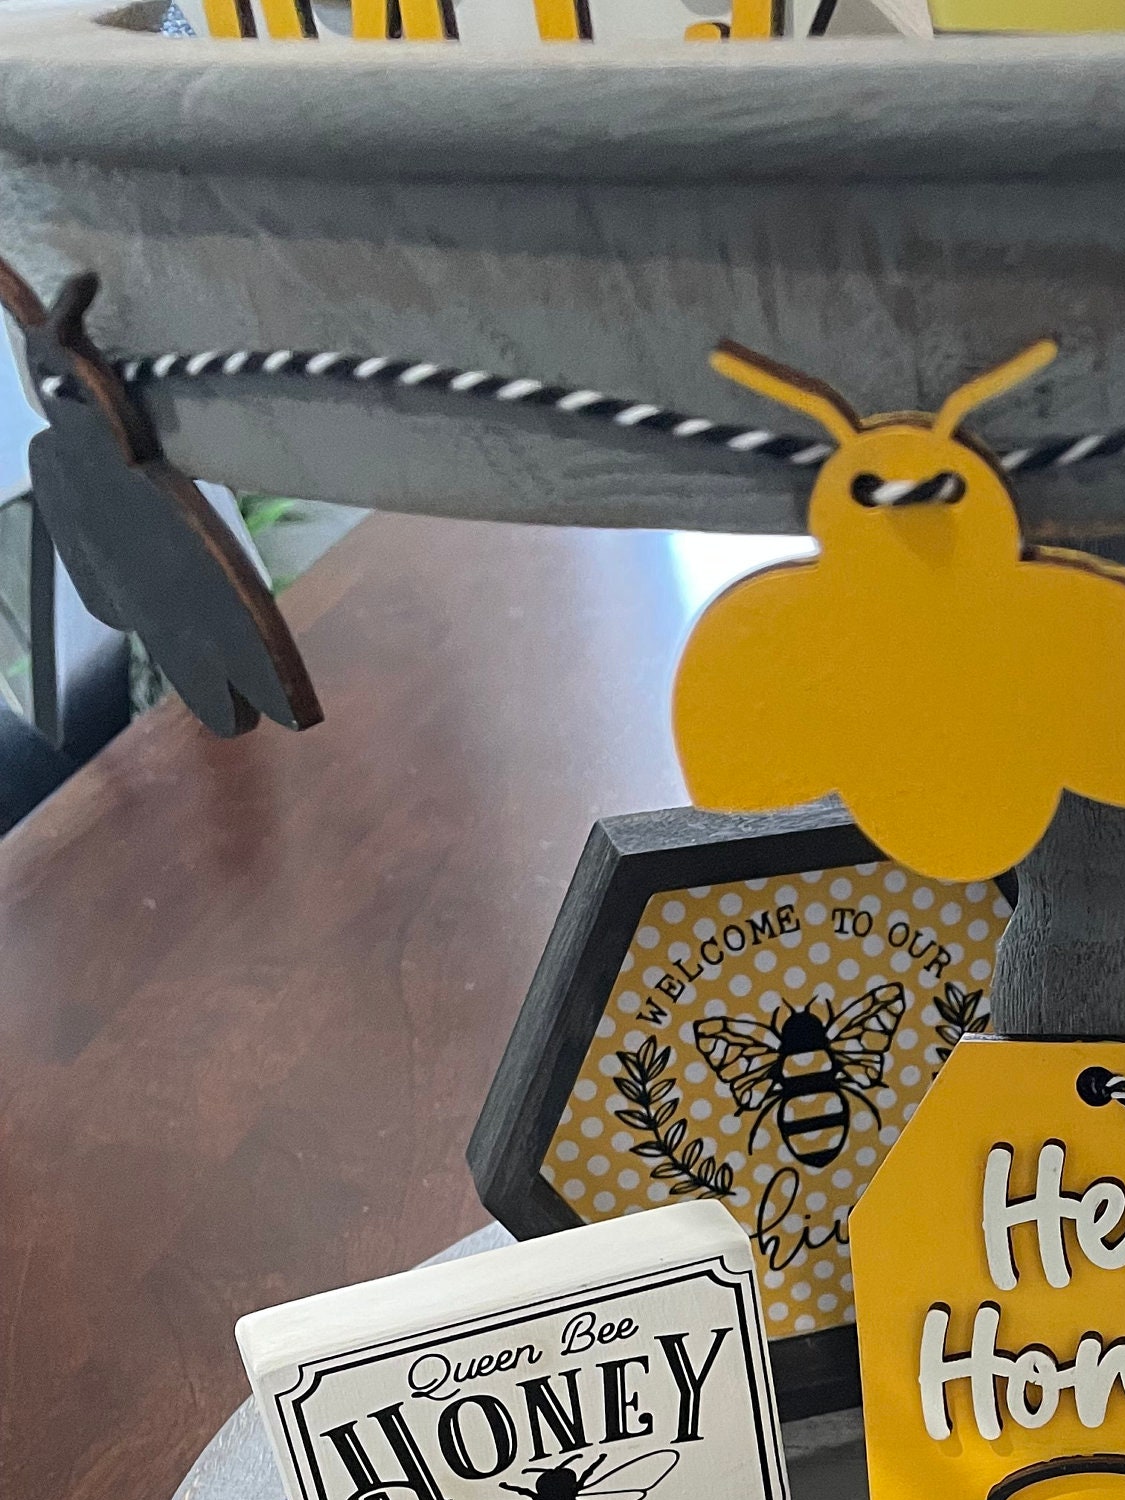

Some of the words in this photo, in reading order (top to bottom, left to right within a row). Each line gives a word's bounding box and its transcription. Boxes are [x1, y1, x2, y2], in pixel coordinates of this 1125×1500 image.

[636, 904, 800, 1027] WELCOME
[831, 907, 873, 938] TO
[888, 922, 952, 978] OUR
[750, 1166, 851, 1271] hiv
[407, 1341, 543, 1400] Queen
[561, 1311, 639, 1357] Bee
